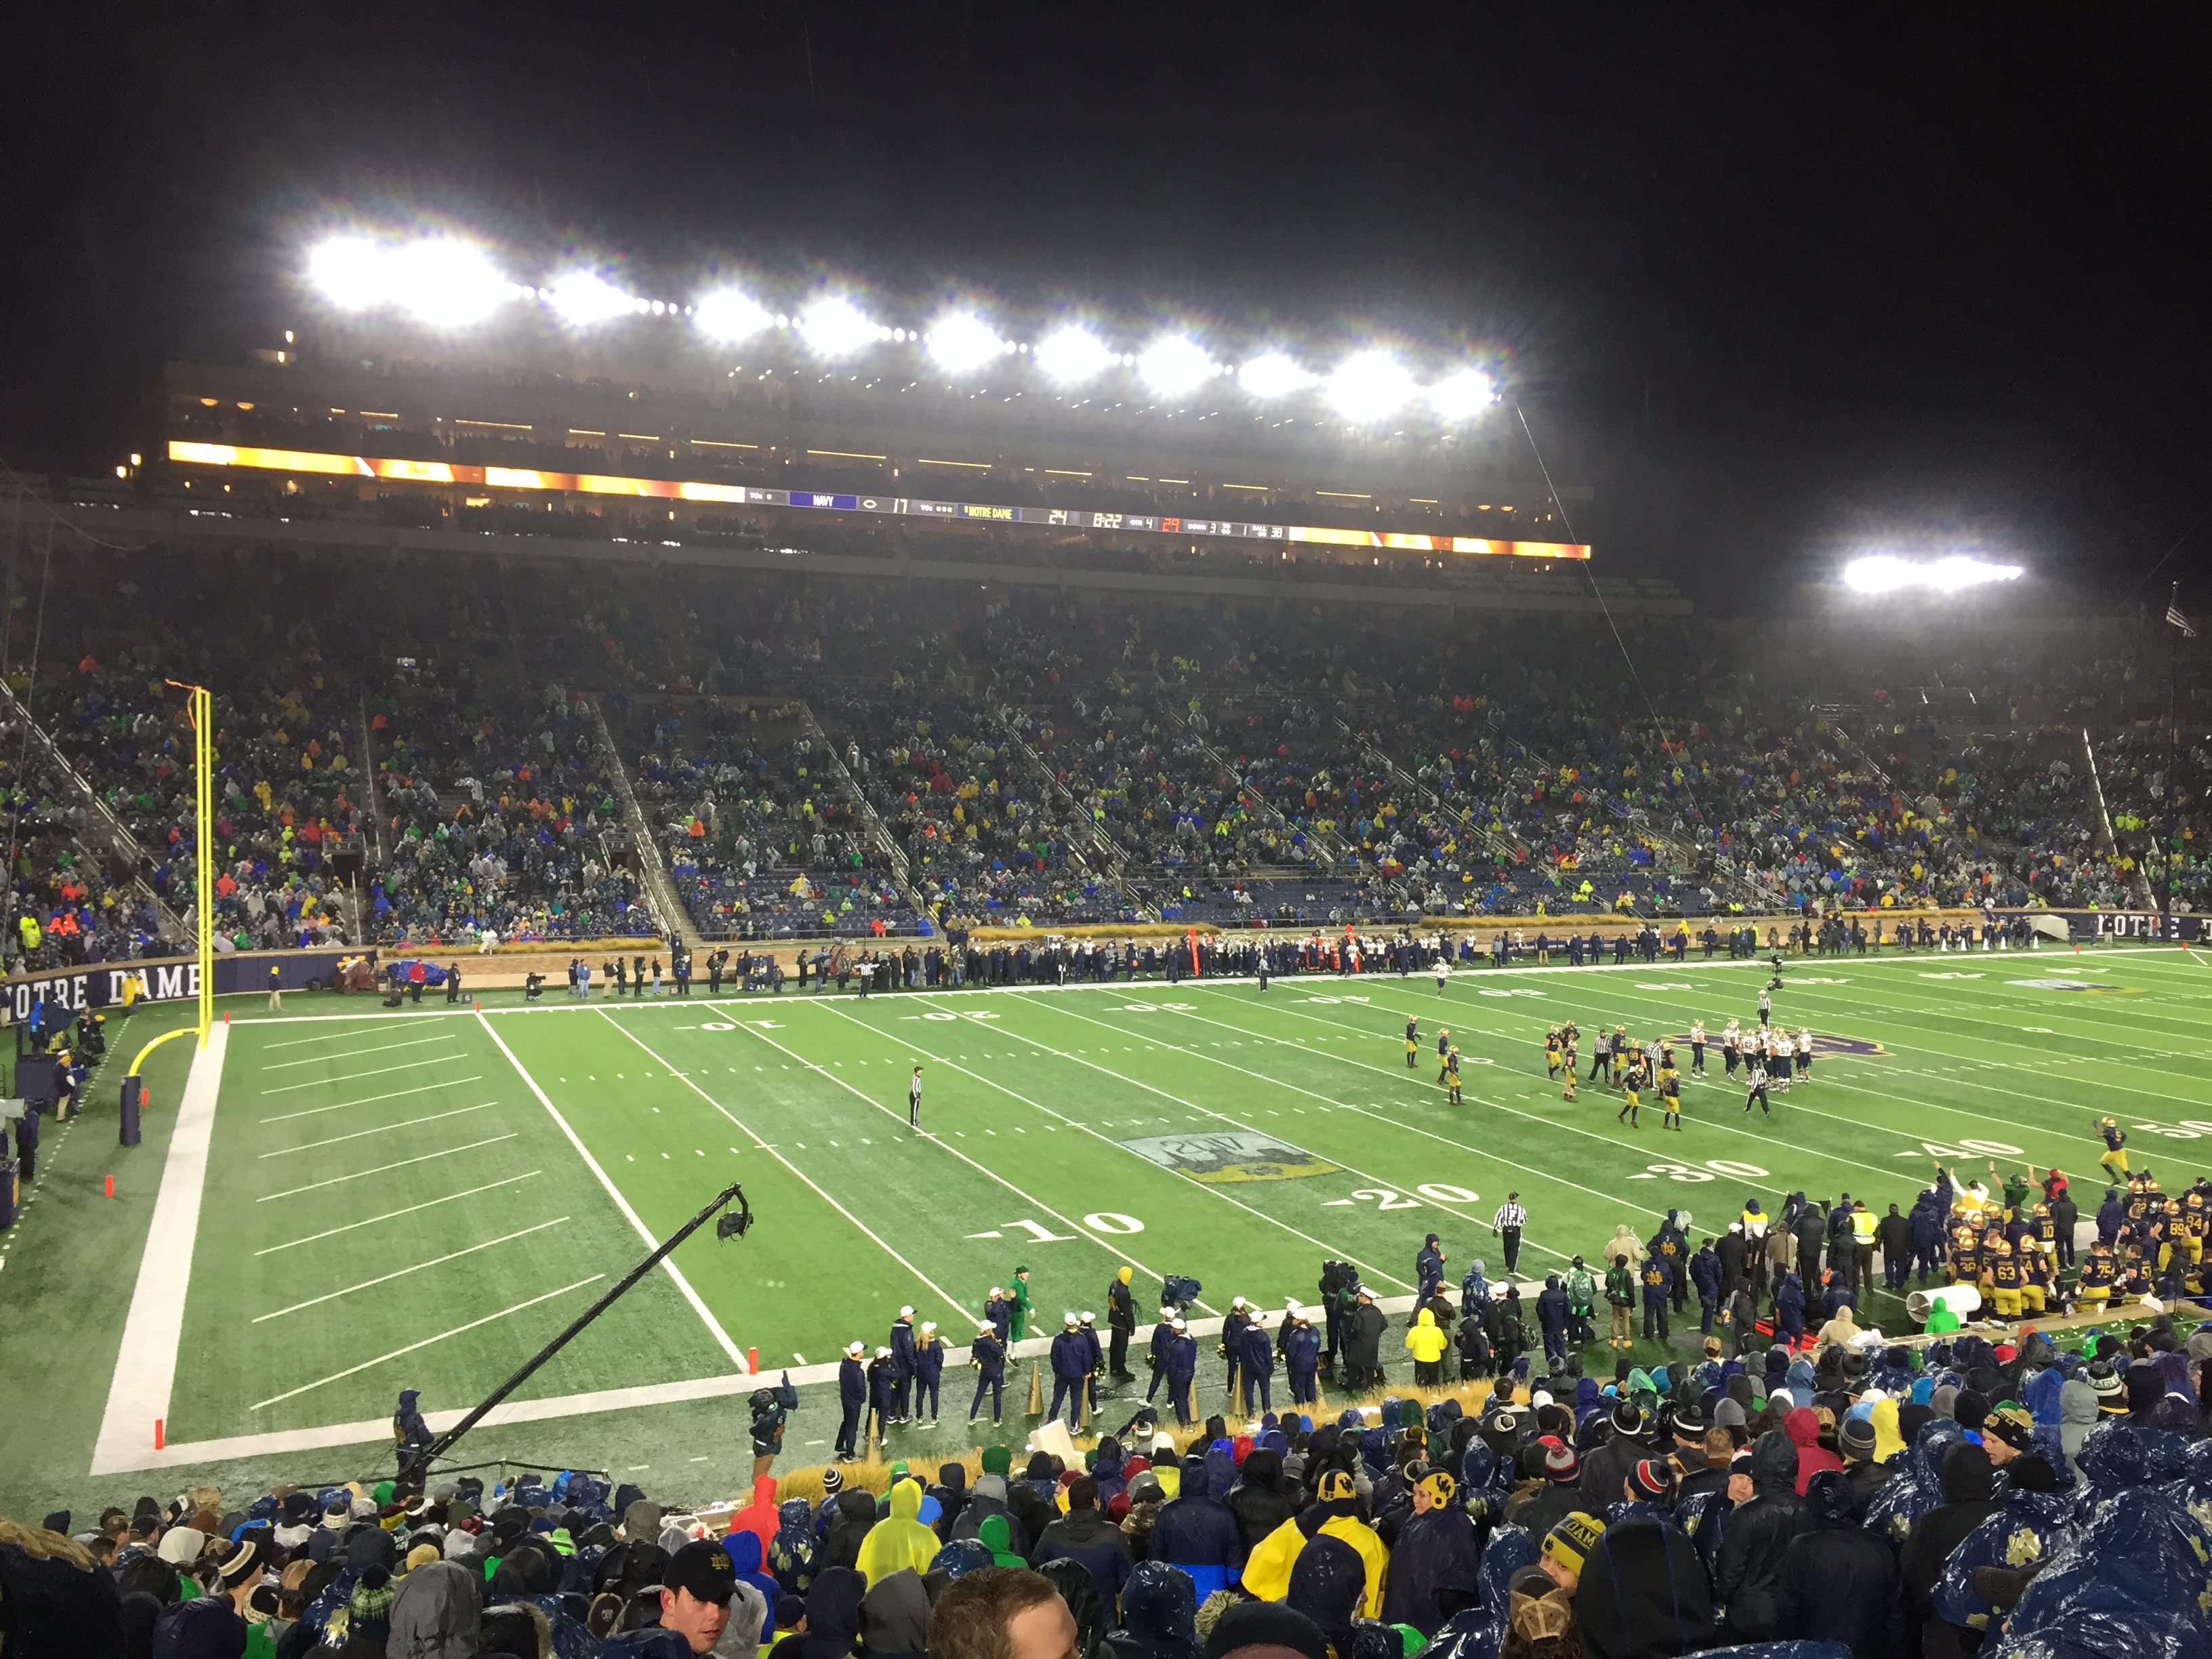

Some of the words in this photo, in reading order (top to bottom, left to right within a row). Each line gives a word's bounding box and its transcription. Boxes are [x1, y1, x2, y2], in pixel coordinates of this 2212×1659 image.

[813, 495, 834, 507] NAVY
[893, 498, 908, 514] 17
[968, 506, 991, 519] NOTRE
[992, 508, 1012, 520] DAME
[1048, 510, 1067, 525] 24
[1092, 512, 1122, 529] 8:22
[1146, 518, 1153, 529] 4
[1162, 517, 1181, 533] 29
[1210, 523, 1217, 534] 3
[1270, 527, 1283, 538] 38
[4, 975, 87, 1021] OTRE
[1744, 1041, 1753, 1050] 62
[1780, 1046, 1789, 1054] 57
[1921, 1139, 2025, 1160] 40
[1646, 1160, 1770, 1182] 30
[1351, 1183, 1480, 1210] 20
[1000, 1212, 1145, 1244] 10
[2043, 1225, 2054, 1239] 10
[2170, 1223, 2184, 1236] 89
[1997, 1266, 2015, 1280] 63
[1722, 1309, 1730, 1323] 2
